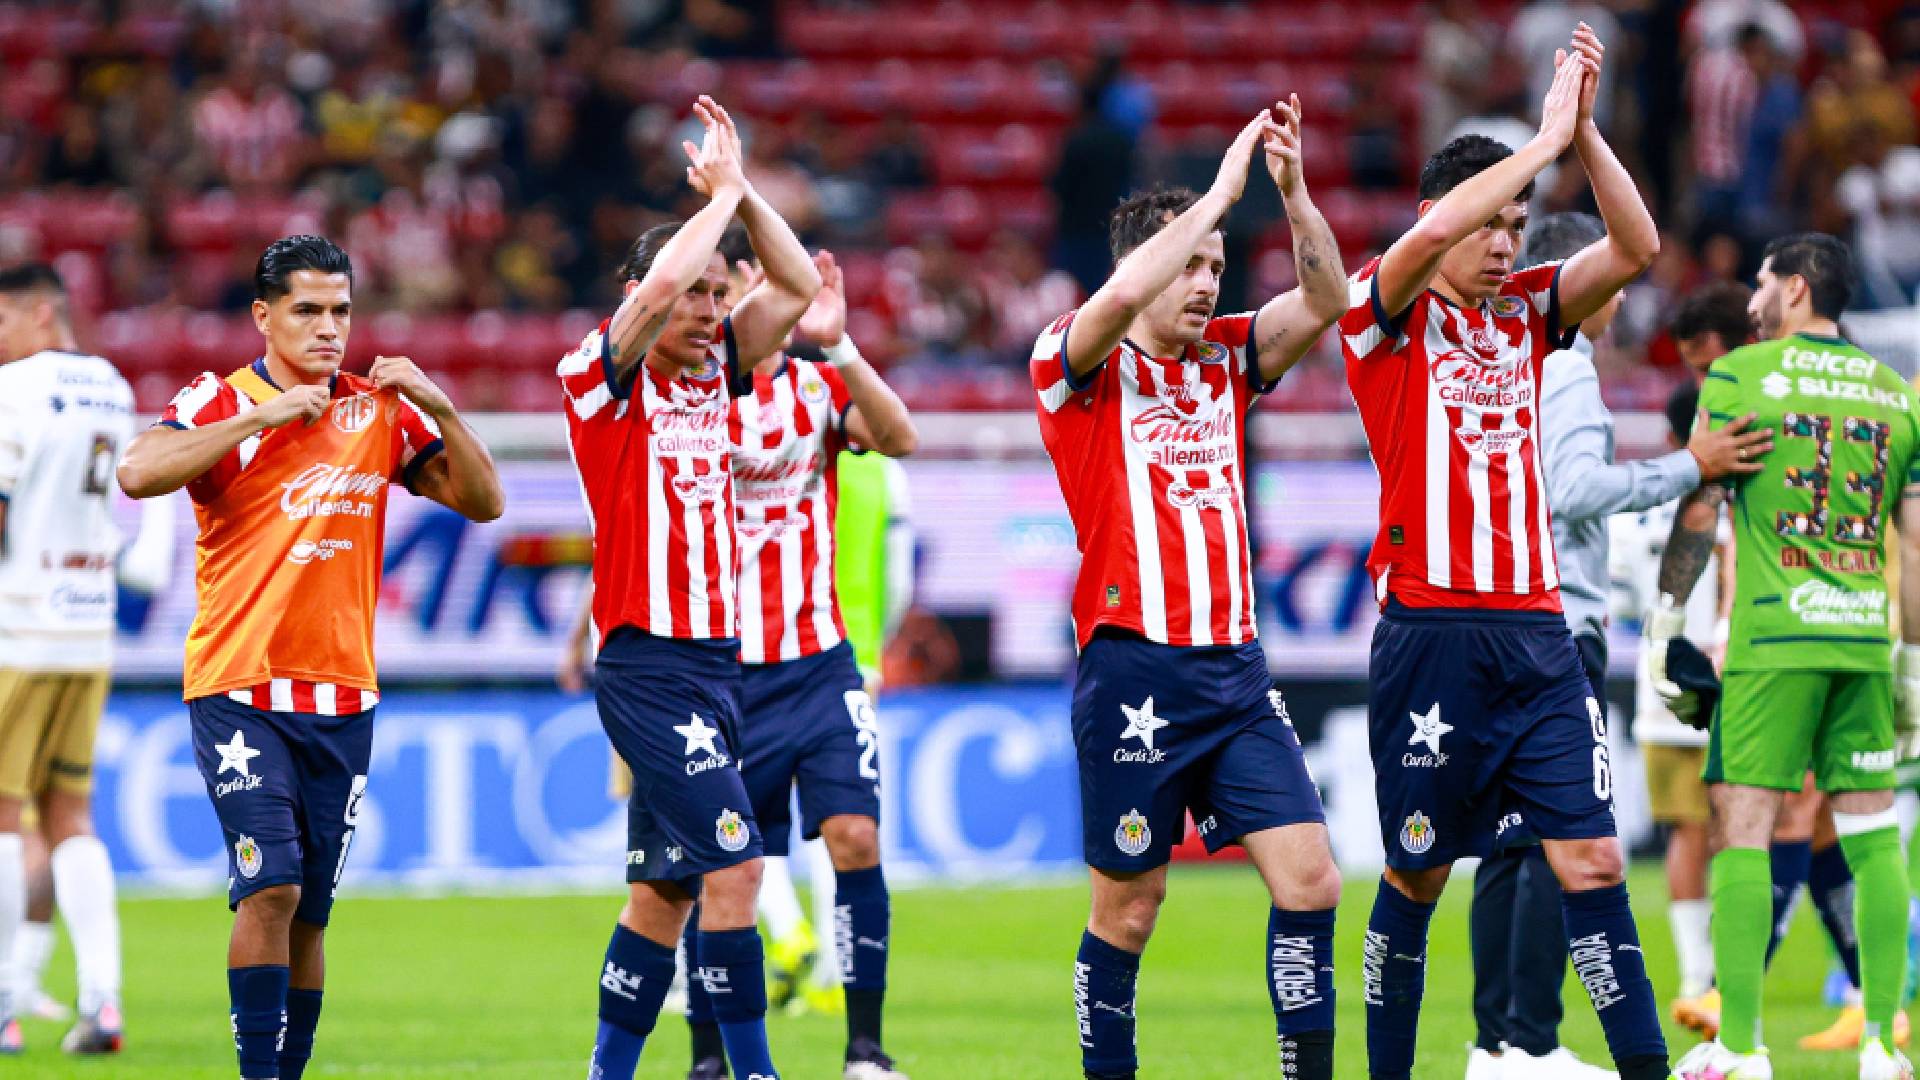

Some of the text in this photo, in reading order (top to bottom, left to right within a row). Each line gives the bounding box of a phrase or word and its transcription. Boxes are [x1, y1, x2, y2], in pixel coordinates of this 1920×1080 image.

[1781, 346, 1877, 378] telcel
[1797, 376, 1909, 410] SUZUKI
[1776, 412, 1890, 543] 33
[1592, 744, 1612, 801] 6
[1271, 933, 1323, 1012] PERDURA
